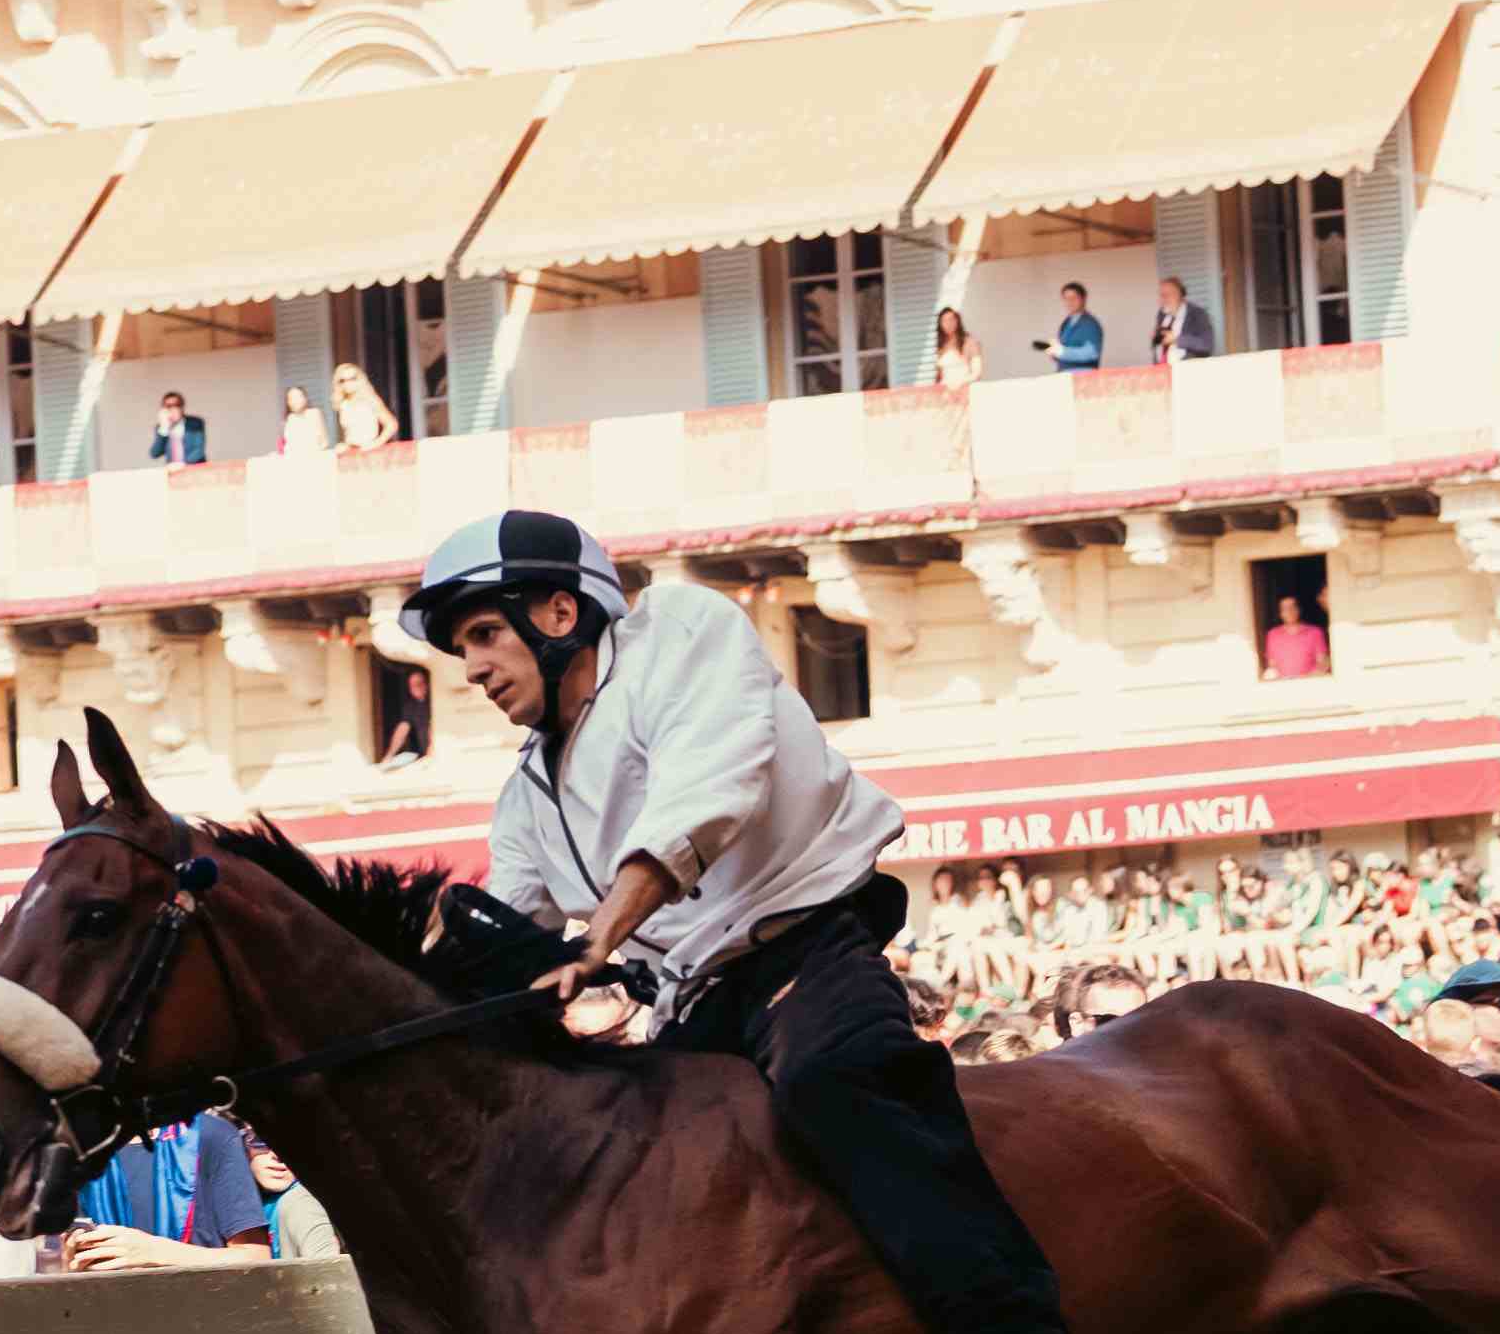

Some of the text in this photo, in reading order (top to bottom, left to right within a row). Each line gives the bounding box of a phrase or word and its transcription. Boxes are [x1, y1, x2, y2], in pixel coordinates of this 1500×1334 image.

[981, 813, 1055, 854] BAR
[1063, 807, 1116, 846] AL
[1124, 794, 1274, 841] MANGIA
